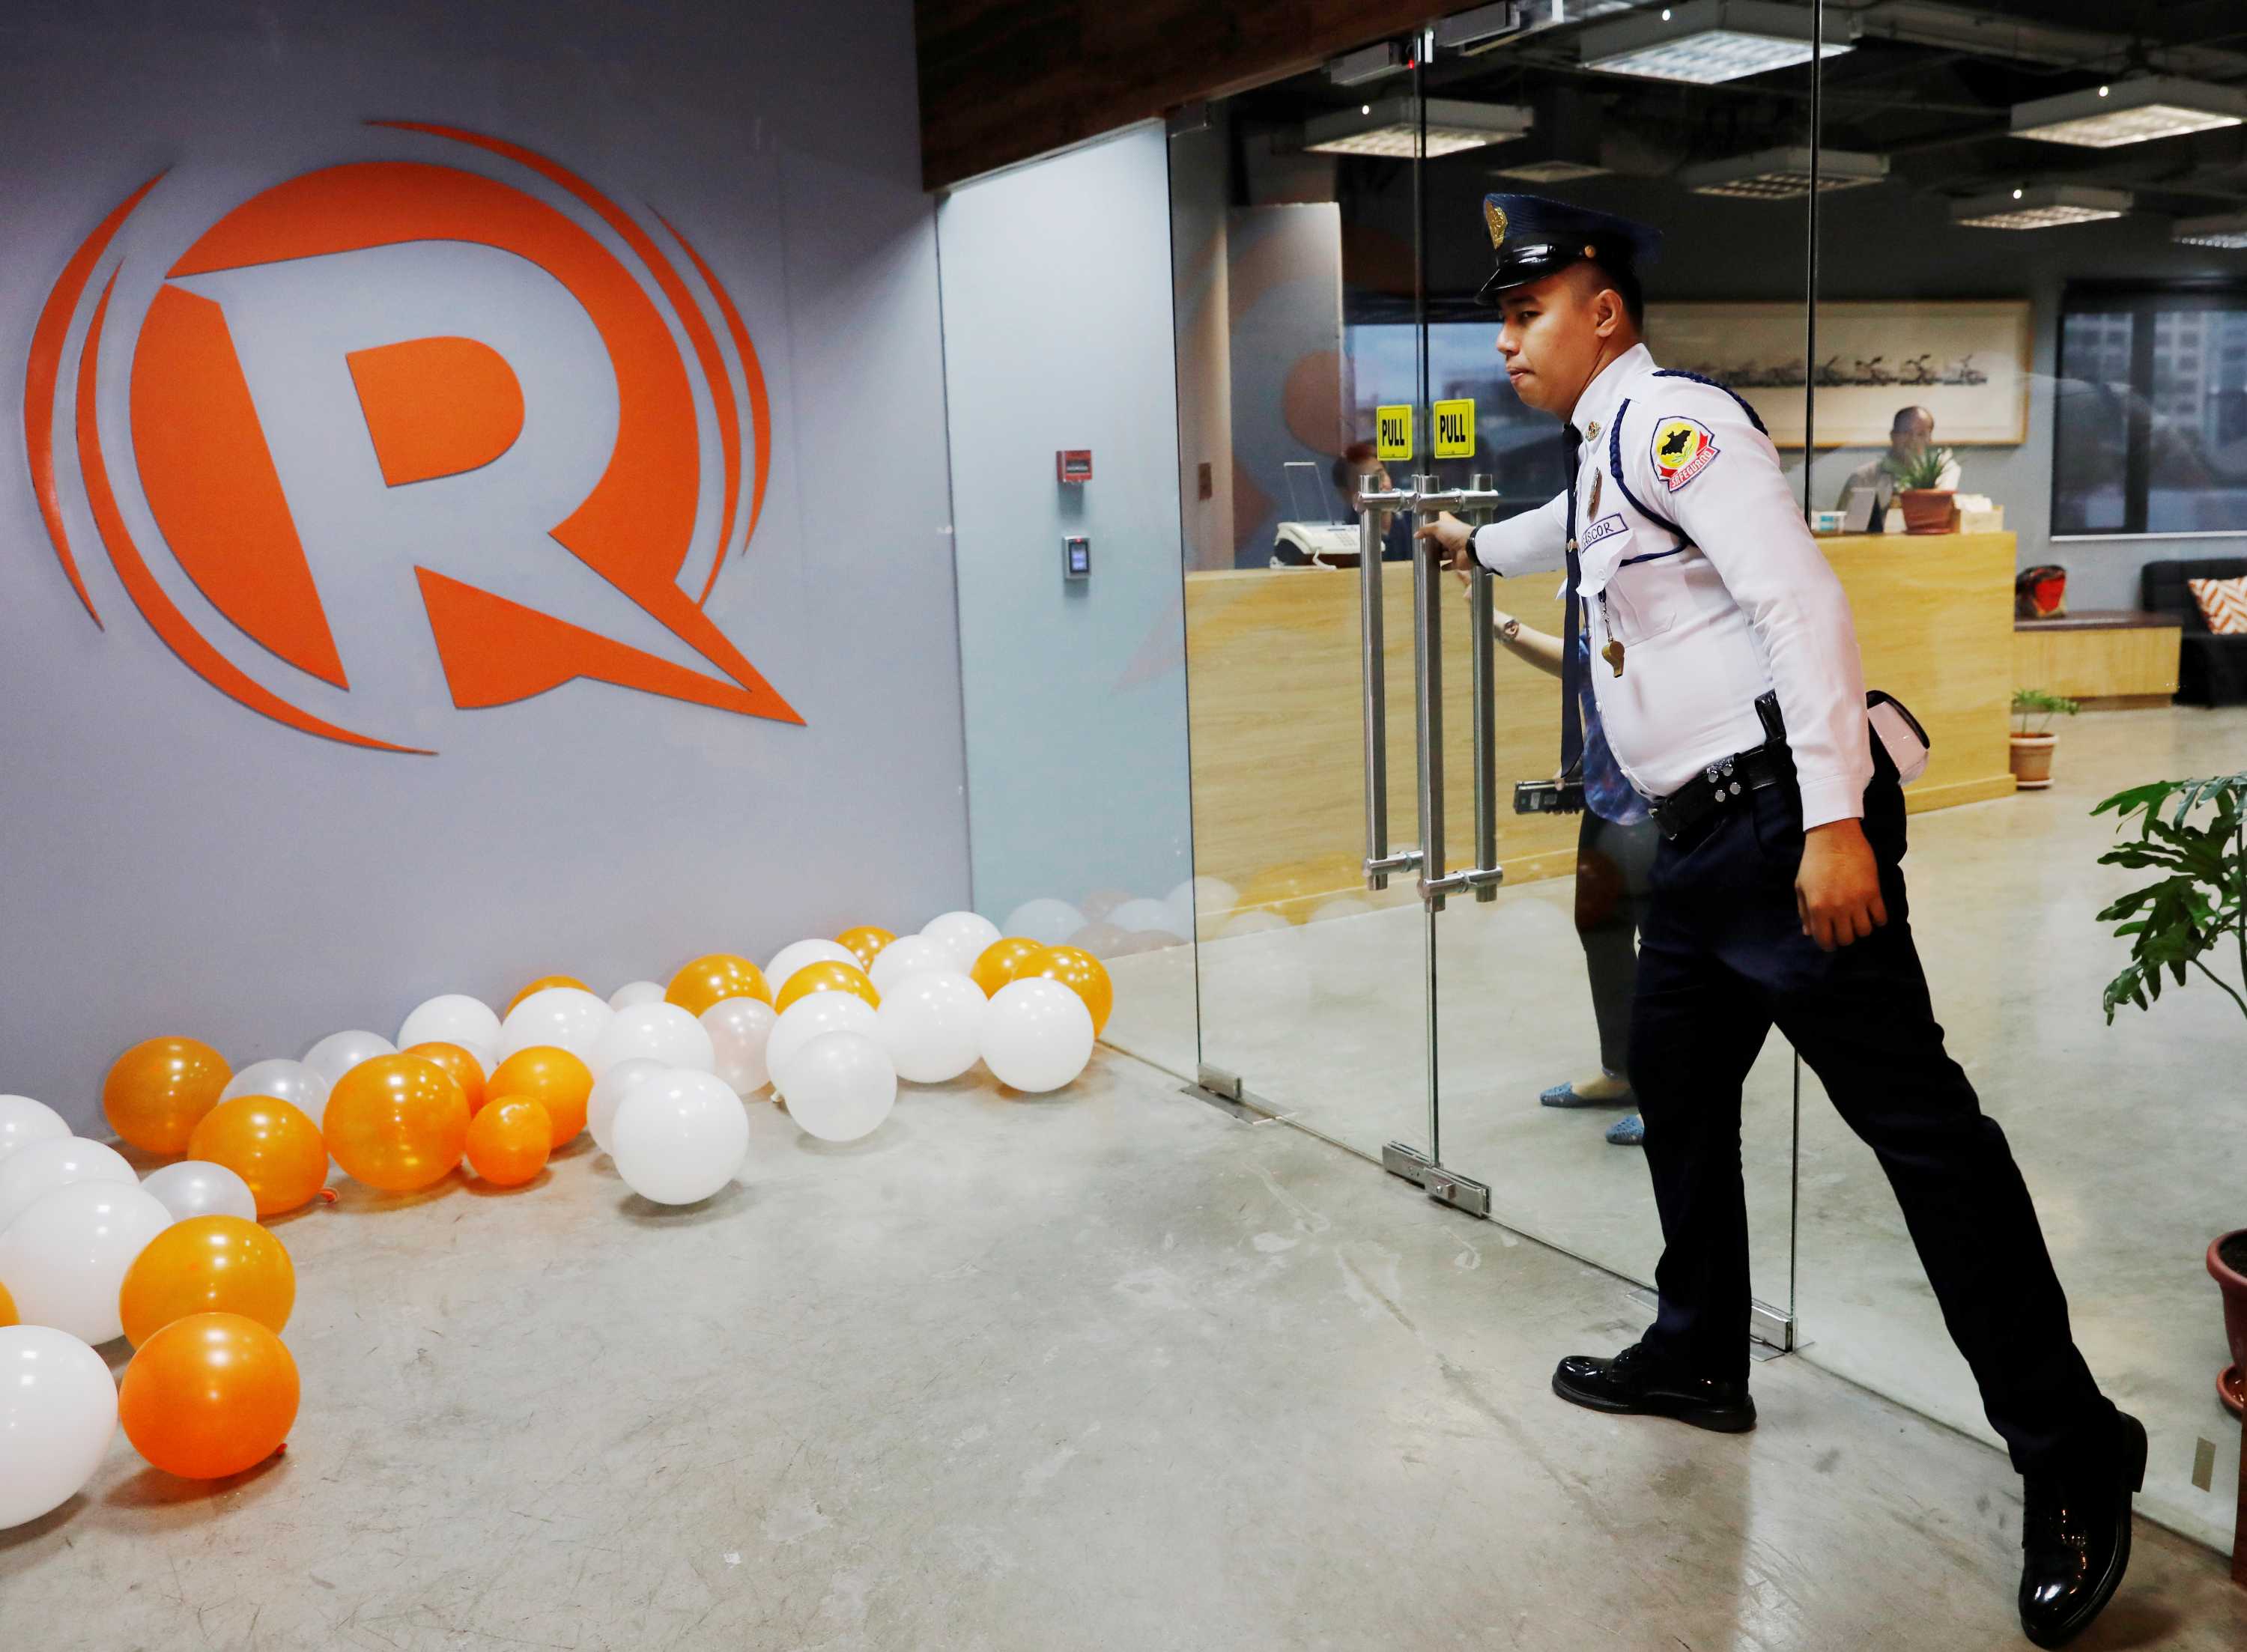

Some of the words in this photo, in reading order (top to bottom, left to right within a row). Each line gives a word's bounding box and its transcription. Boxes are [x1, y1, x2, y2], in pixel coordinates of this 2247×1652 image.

[1382, 419, 1404, 446] PULL
[1440, 413, 1466, 443] PULL
[1670, 449, 1713, 488] SAFEGUARD
